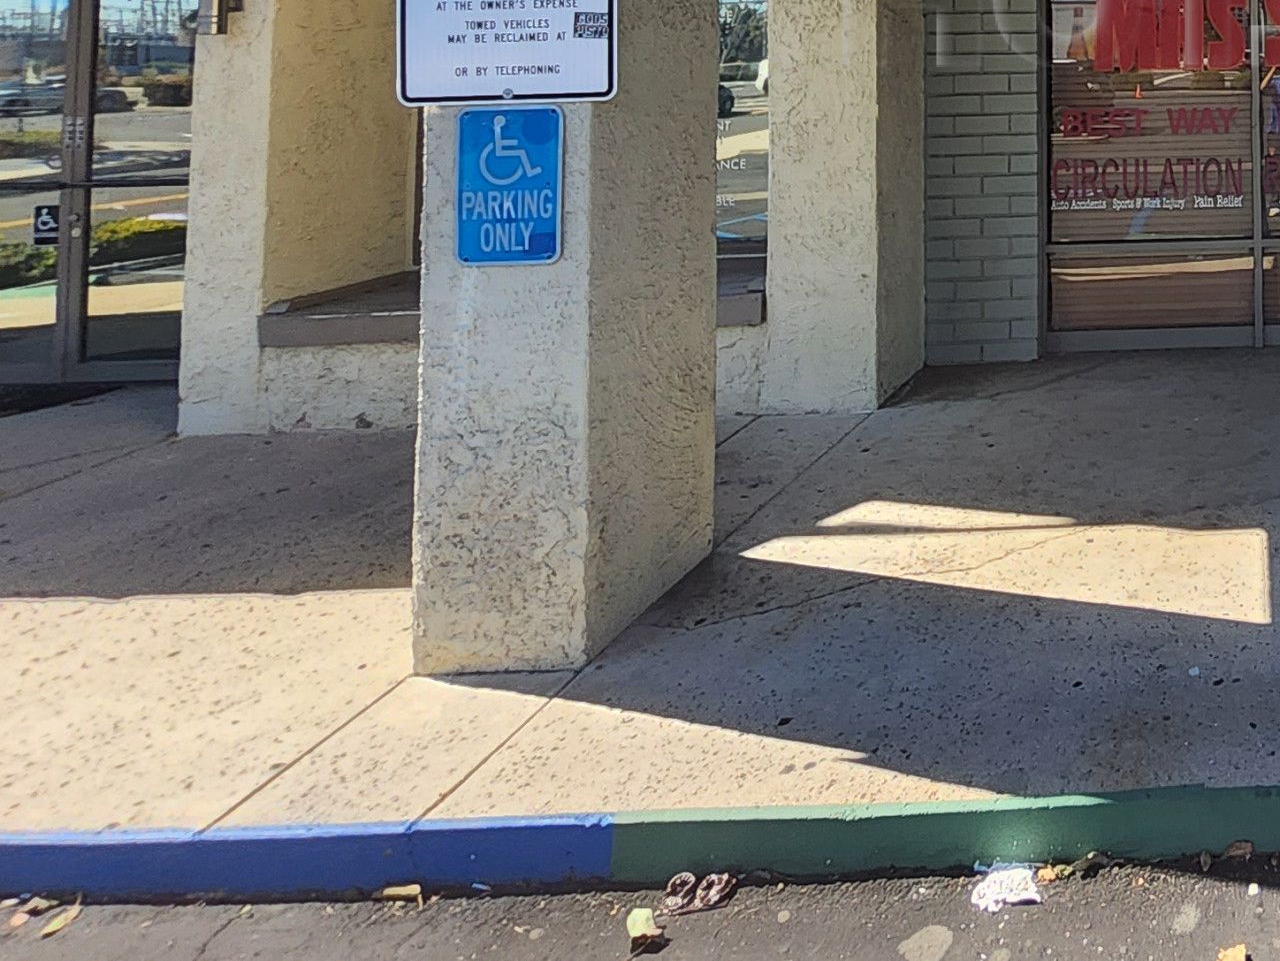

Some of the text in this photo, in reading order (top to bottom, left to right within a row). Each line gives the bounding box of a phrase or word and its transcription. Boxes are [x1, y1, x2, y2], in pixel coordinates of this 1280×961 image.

[436, 1, 447, 11] AT
[454, 0, 473, 11] THE
[480, 0, 526, 10] OWNER'S
[465, 19, 550, 30] TOWED VEHICLES
[447, 31, 567, 44] MAY BE RECLAIMED AT
[454, 65, 561, 76] OR BY TELEPHONING
[1061, 105, 1149, 138] BEST
[1168, 107, 1238, 136] WAY
[1051, 156, 1244, 200] CIRCULATION
[1193, 194, 1213, 208] Pain
[1217, 194, 1244, 208] Relief
[462, 189, 553, 252] PARKING ONLY
